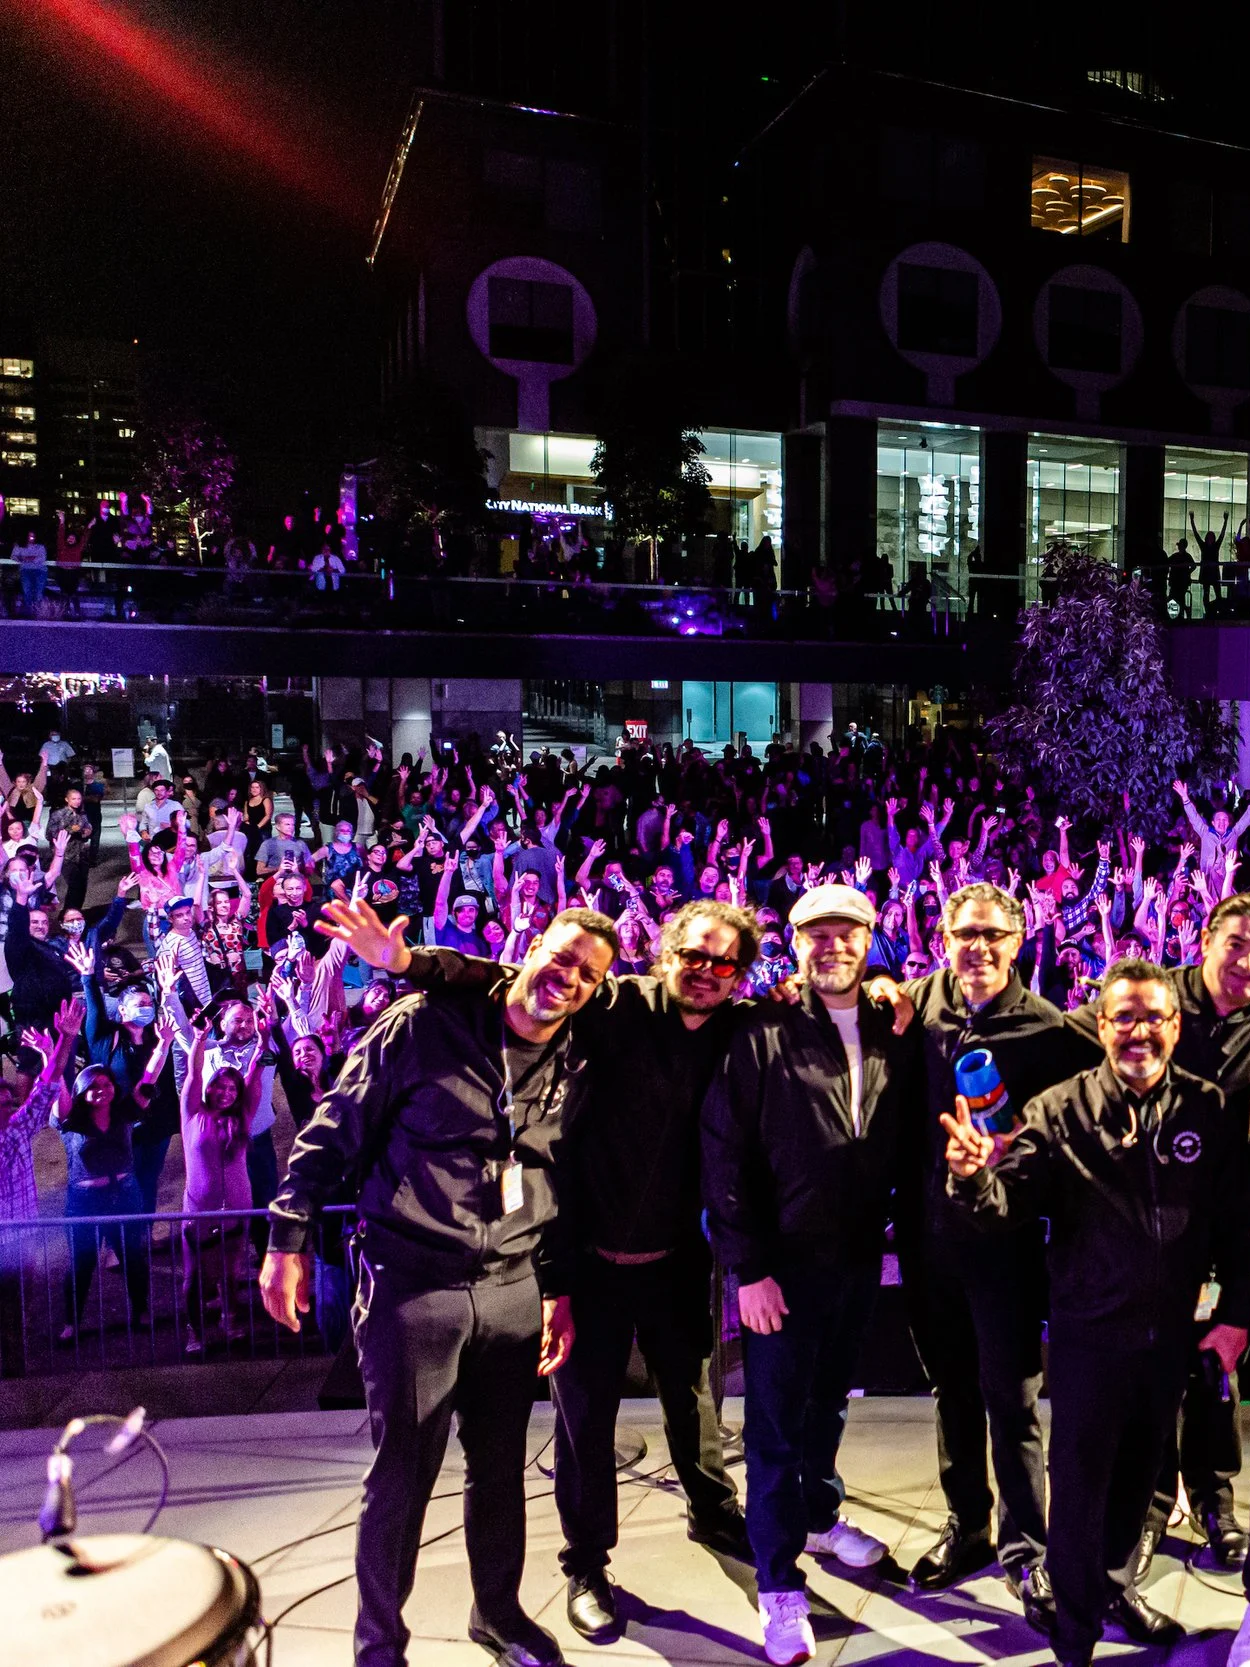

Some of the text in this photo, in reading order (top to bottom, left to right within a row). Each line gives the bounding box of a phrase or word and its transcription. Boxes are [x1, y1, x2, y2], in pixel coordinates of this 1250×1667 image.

[511, 500, 570, 514] NATIONAL
[570, 503, 602, 515] BANK
[626, 725, 648, 738] EXIT
